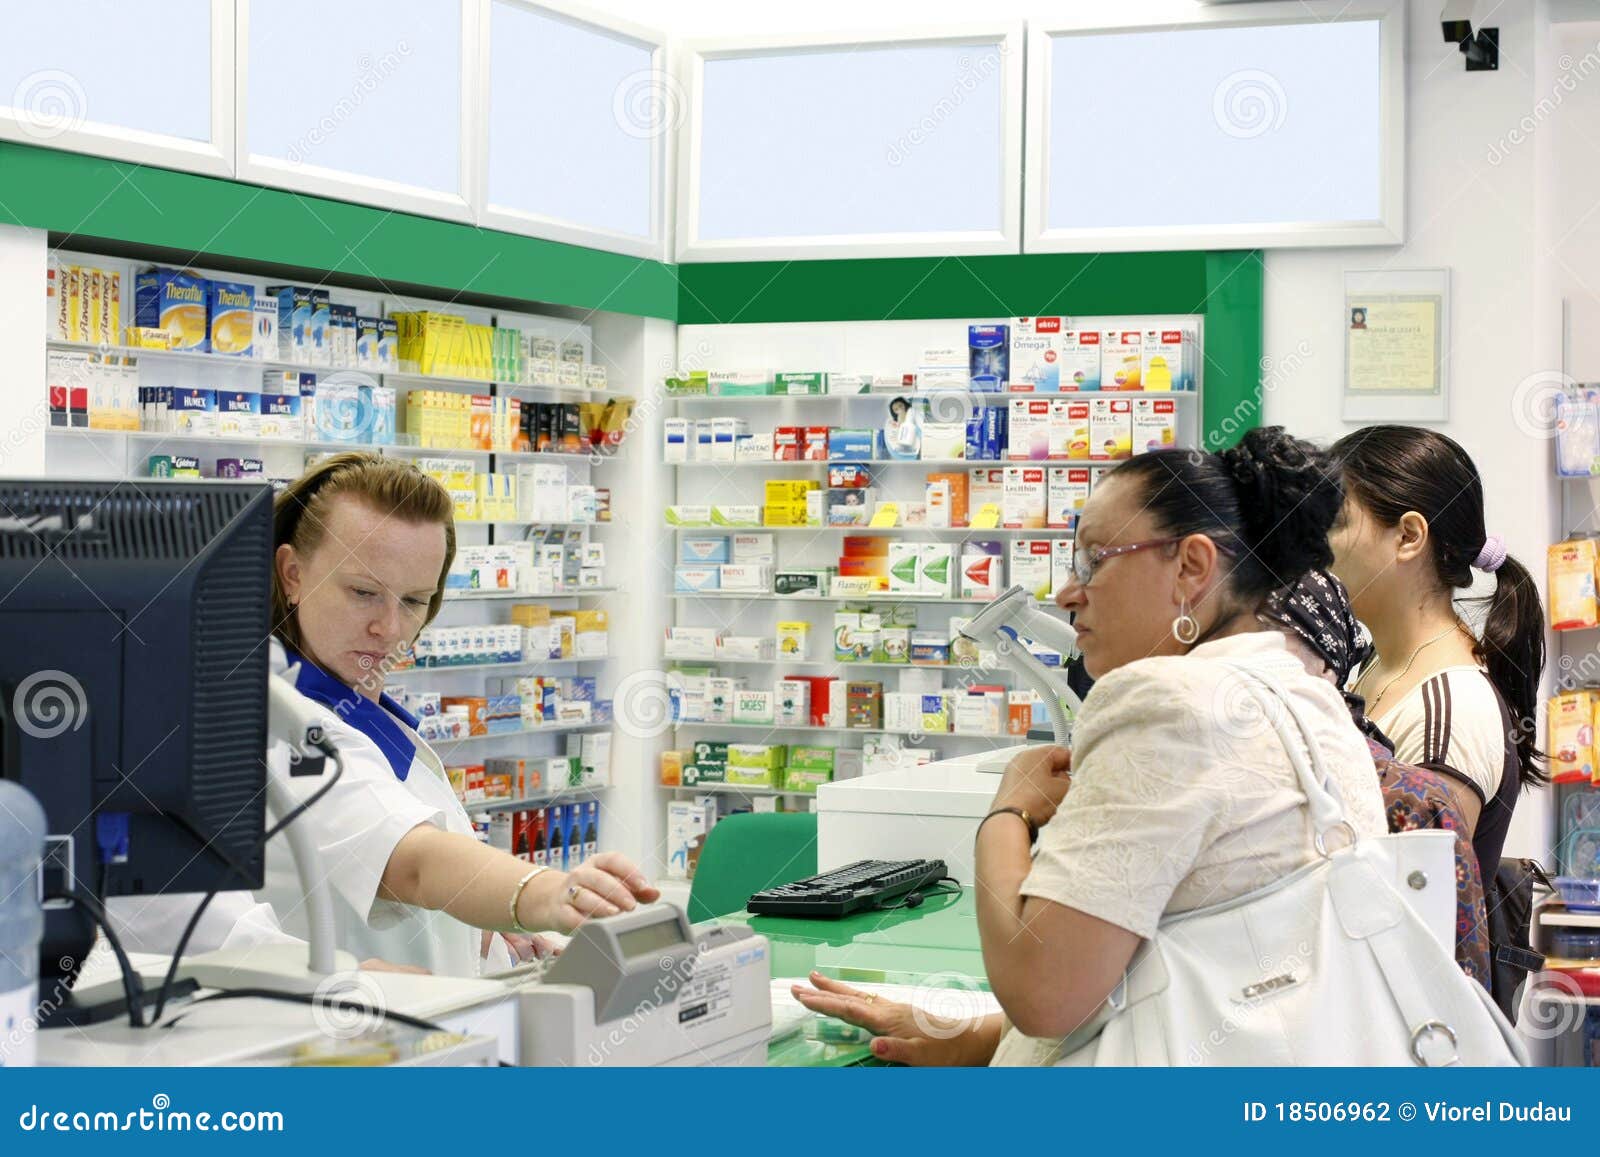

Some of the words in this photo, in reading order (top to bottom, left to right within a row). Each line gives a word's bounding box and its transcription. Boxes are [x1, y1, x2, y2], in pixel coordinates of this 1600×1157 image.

[166, 282, 203, 302] Theraflu
[217, 288, 251, 309] Theraflu
[1037, 320, 1059, 328] aktiv
[1014, 341, 1045, 351] Omega
[184, 396, 206, 408] HUMEX
[228, 400, 250, 411] HUMEX
[269, 404, 291, 414] HUMEX
[1005, 484, 1037, 493] Lecithin
[1562, 552, 1578, 561] NUK
[837, 580, 871, 593] Flamigel
